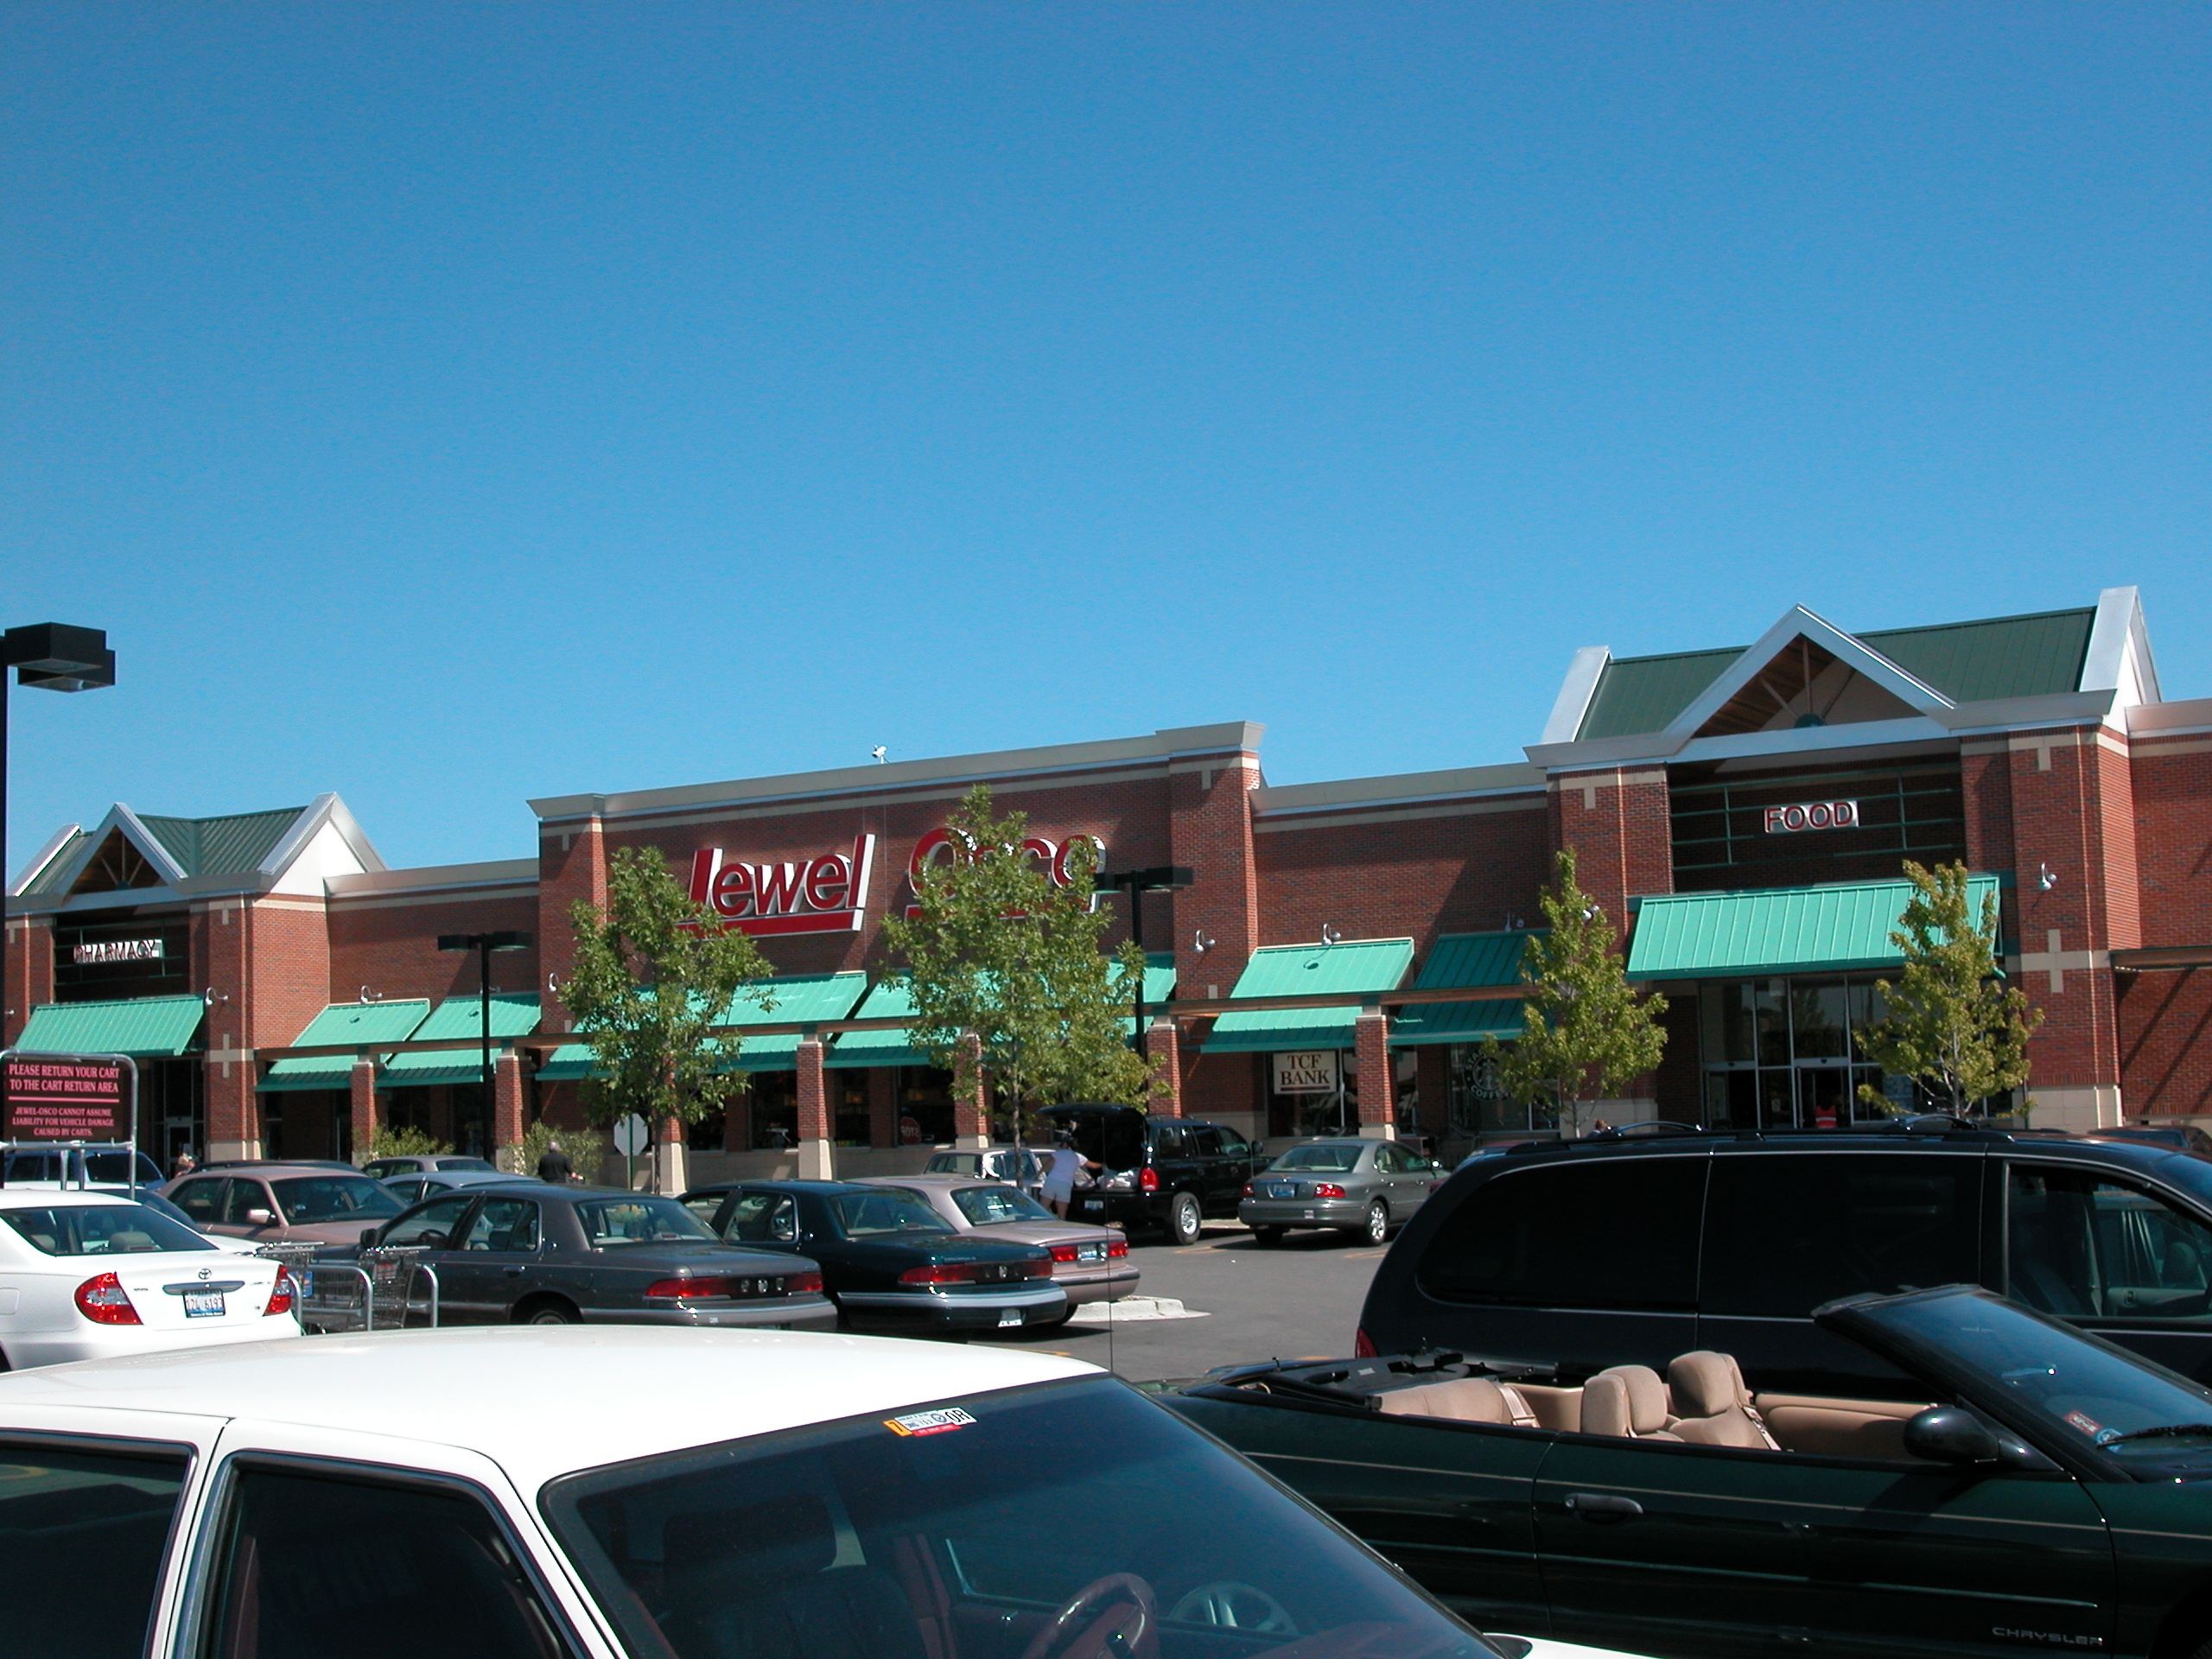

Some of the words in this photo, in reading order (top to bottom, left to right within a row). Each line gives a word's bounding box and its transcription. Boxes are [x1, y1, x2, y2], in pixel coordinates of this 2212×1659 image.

[1764, 801, 1857, 833] FOOD
[73, 940, 158, 963] PHARMACY
[1287, 1054, 1321, 1069] TCF
[10, 1065, 40, 1076] PLEASE
[42, 1065, 74, 1077] RETURN
[75, 1066, 98, 1078] YOUR
[99, 1067, 120, 1078] CART
[1281, 1070, 1329, 1084] BANK
[10, 1079, 22, 1090] TO
[24, 1080, 40, 1090] THE
[41, 1080, 62, 1091] CART
[65, 1081, 96, 1092] RETURN
[98, 1082, 118, 1093] AREA
[16, 1107, 57, 1116] JEWEL-OSCO
[1992, 1627, 2103, 1646] CHRYSLER
